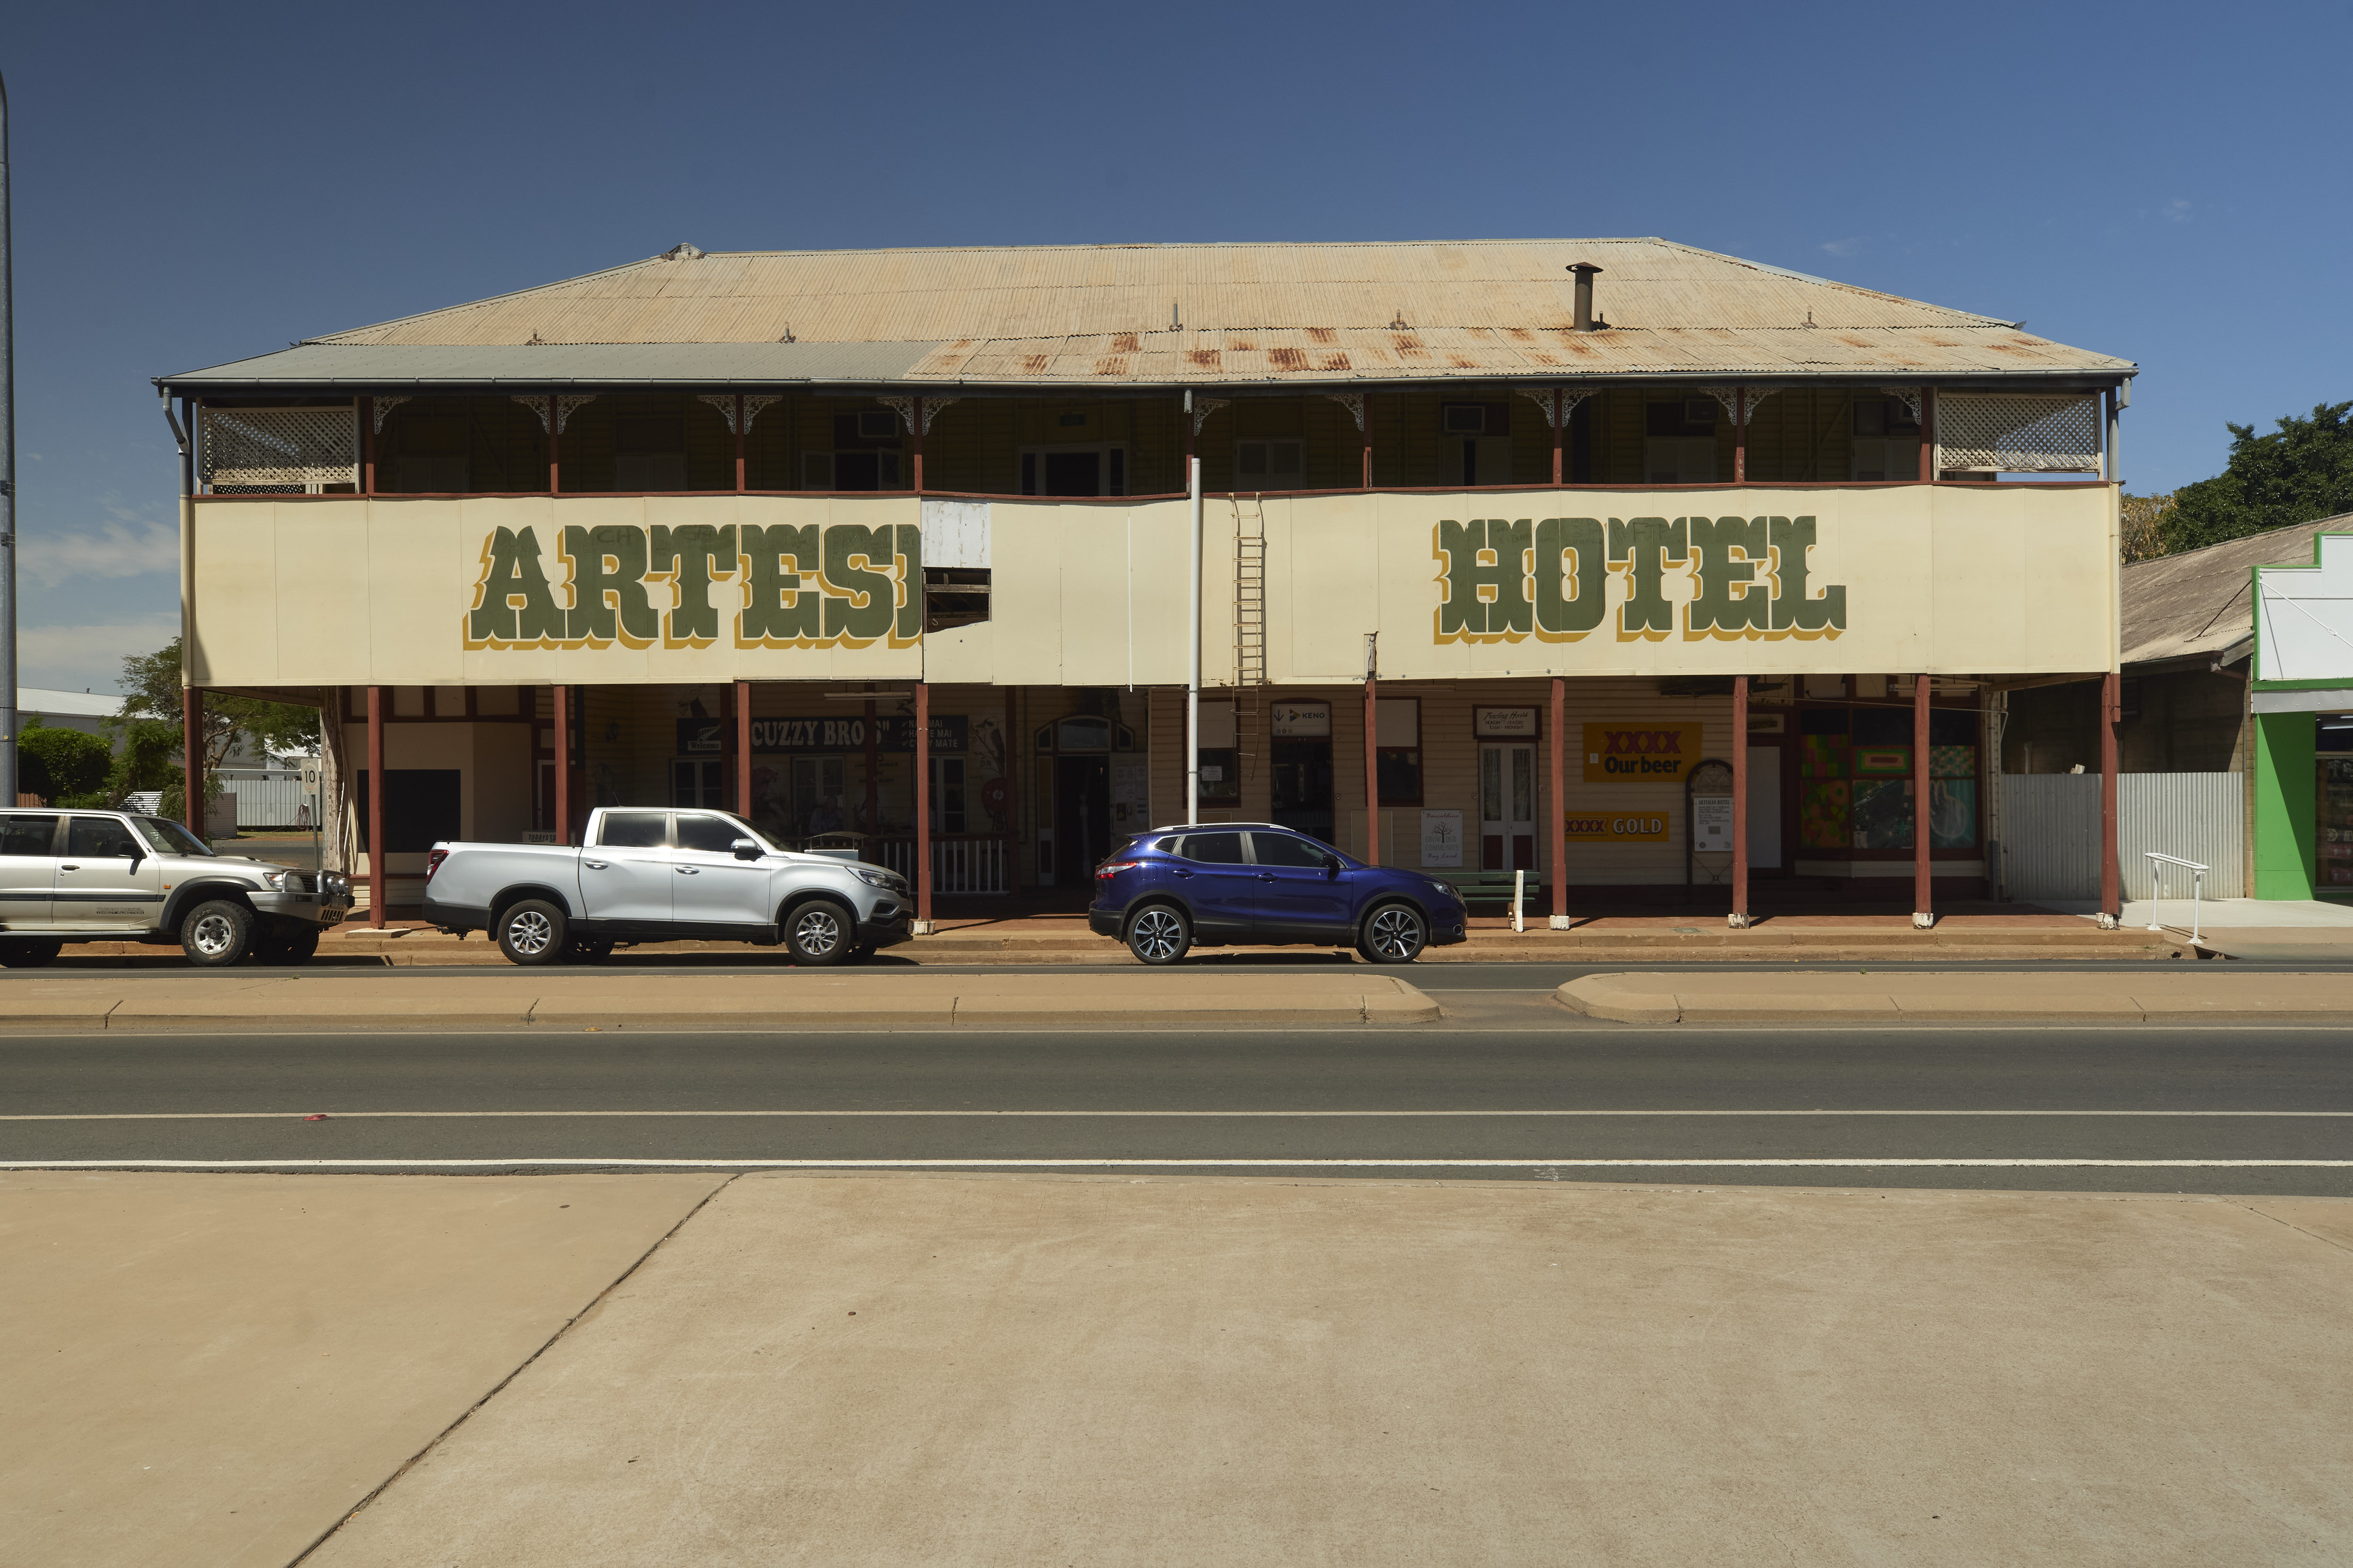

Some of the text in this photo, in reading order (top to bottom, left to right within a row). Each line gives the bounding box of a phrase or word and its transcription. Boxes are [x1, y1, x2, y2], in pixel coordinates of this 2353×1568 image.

[1433, 515, 1847, 644] HOTEL
[1483, 712, 1508, 722] Trading
[751, 721, 818, 746] CUZZY
[937, 729, 952, 737] MAI
[935, 740, 958, 748] MATE
[1604, 731, 1682, 754] XXXX
[1604, 756, 1682, 773] Our beer
[305, 770, 315, 783] 10
[1564, 818, 1664, 835] XXXX GOLD
[1428, 853, 1439, 861] Buy
